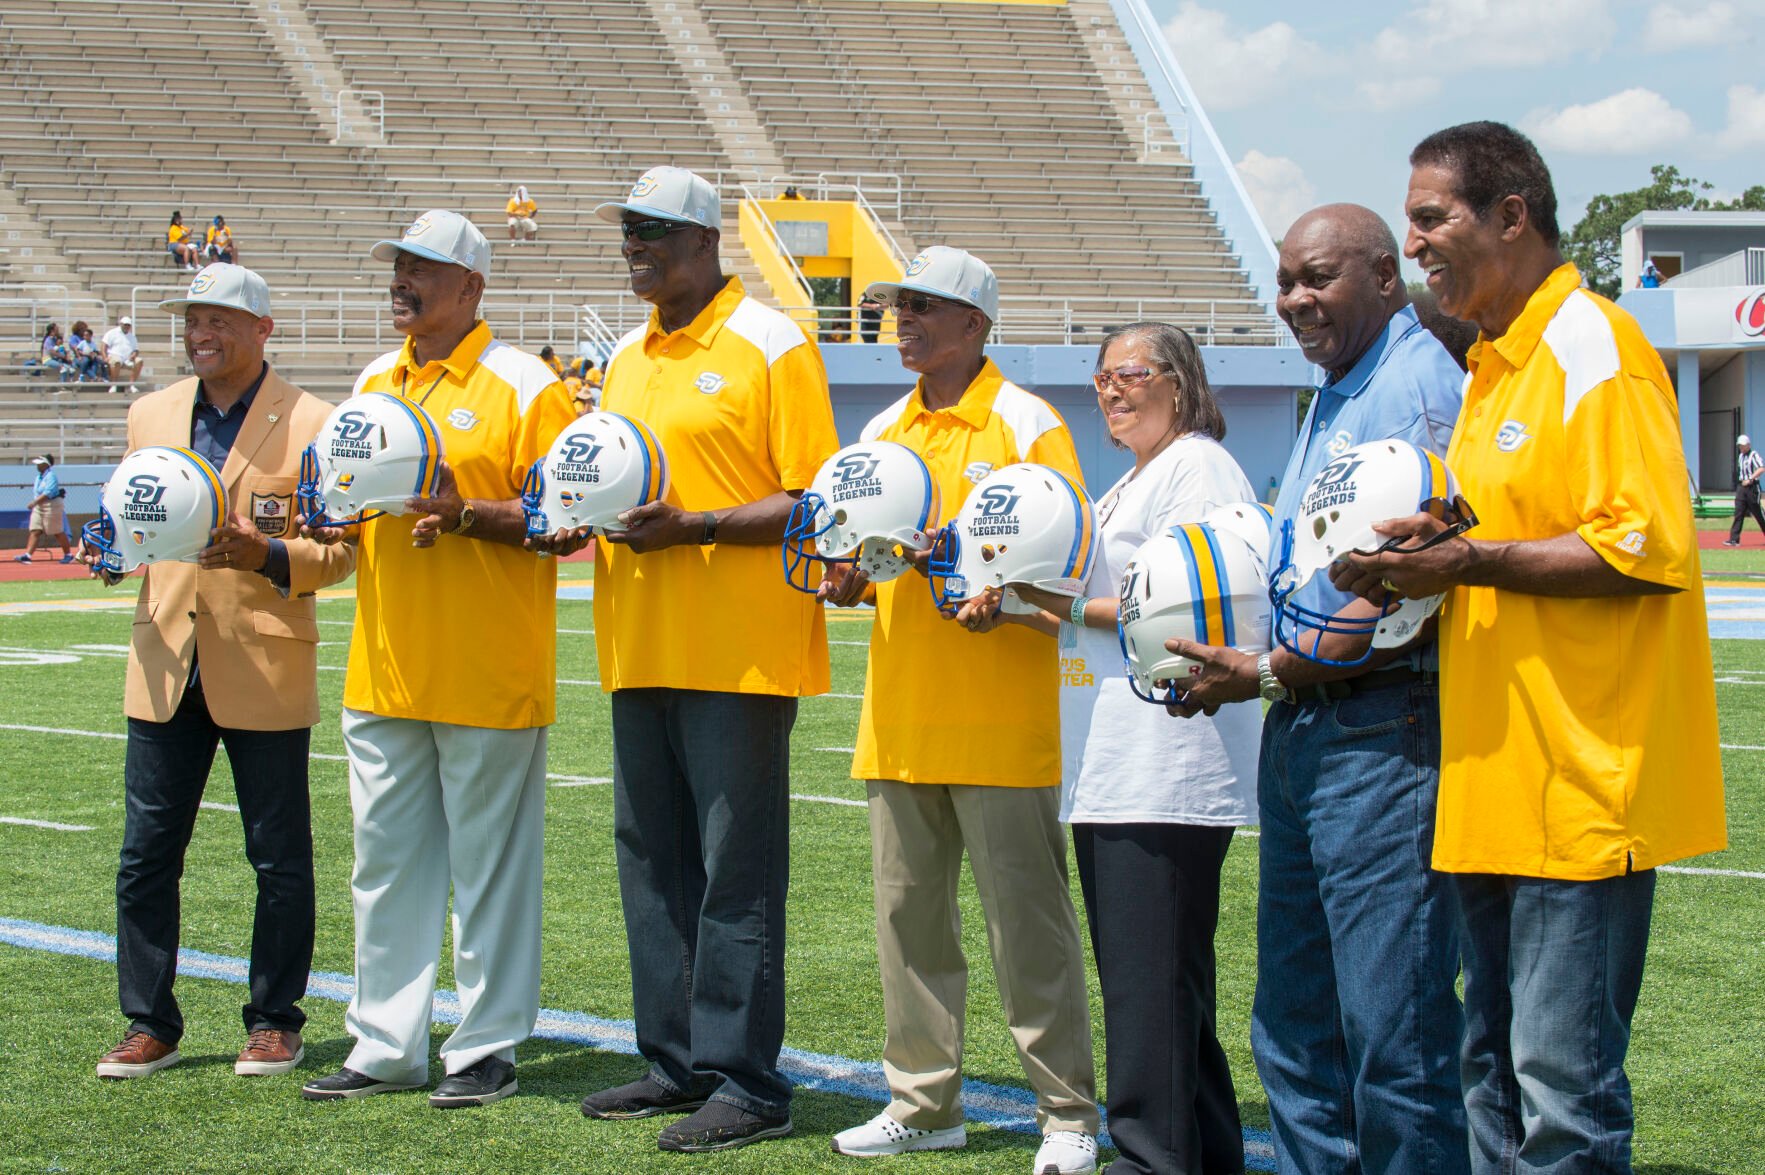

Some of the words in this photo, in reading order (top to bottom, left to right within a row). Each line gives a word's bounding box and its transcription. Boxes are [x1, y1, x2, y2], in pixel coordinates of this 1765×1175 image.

[333, 411, 377, 441] SU
[331, 439, 373, 450] FOOTBALL
[560, 433, 604, 464] SU
[331, 448, 372, 459] LEGENDS
[557, 463, 600, 473] FOOTBALL
[832, 452, 881, 483] SU
[1311, 453, 1365, 490] SU
[556, 472, 600, 483] LEGENDS
[125, 474, 168, 505] SU
[832, 478, 882, 494] FOOTBALL
[1307, 481, 1357, 505] FOOTBALL
[833, 486, 882, 503] LEGENDS
[975, 484, 1022, 517] SU
[125, 504, 167, 513] FOOTBALL
[1306, 492, 1356, 516] LEGENDS
[125, 512, 167, 522] LEGENDS
[973, 516, 1020, 526] FOOTBALL
[973, 525, 1020, 537] LEGENDS
